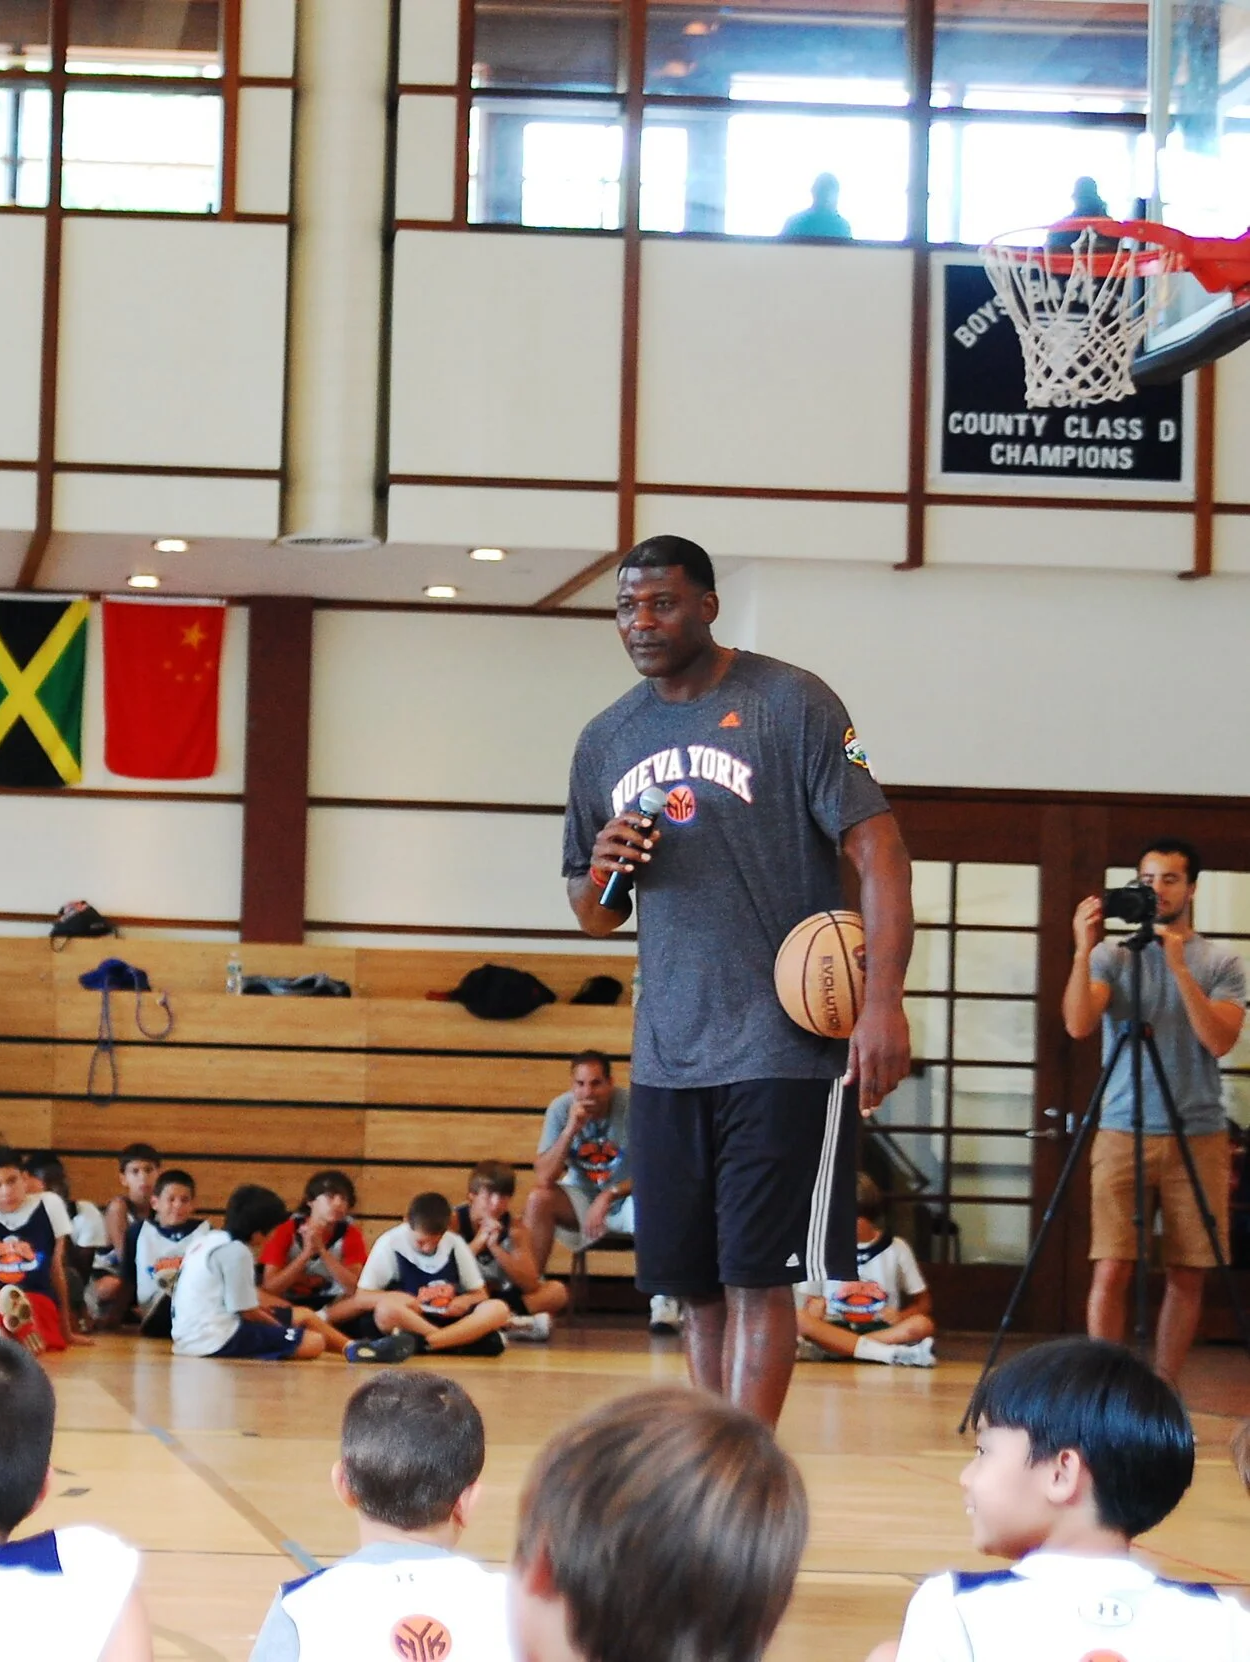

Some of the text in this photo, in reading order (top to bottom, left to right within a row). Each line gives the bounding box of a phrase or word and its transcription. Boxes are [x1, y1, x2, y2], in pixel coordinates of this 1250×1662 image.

[948, 411, 1176, 442] COUNTY CLASS D
[990, 443, 1134, 470] CHAMPIONS
[611, 745, 752, 818] NUEVA YORK
